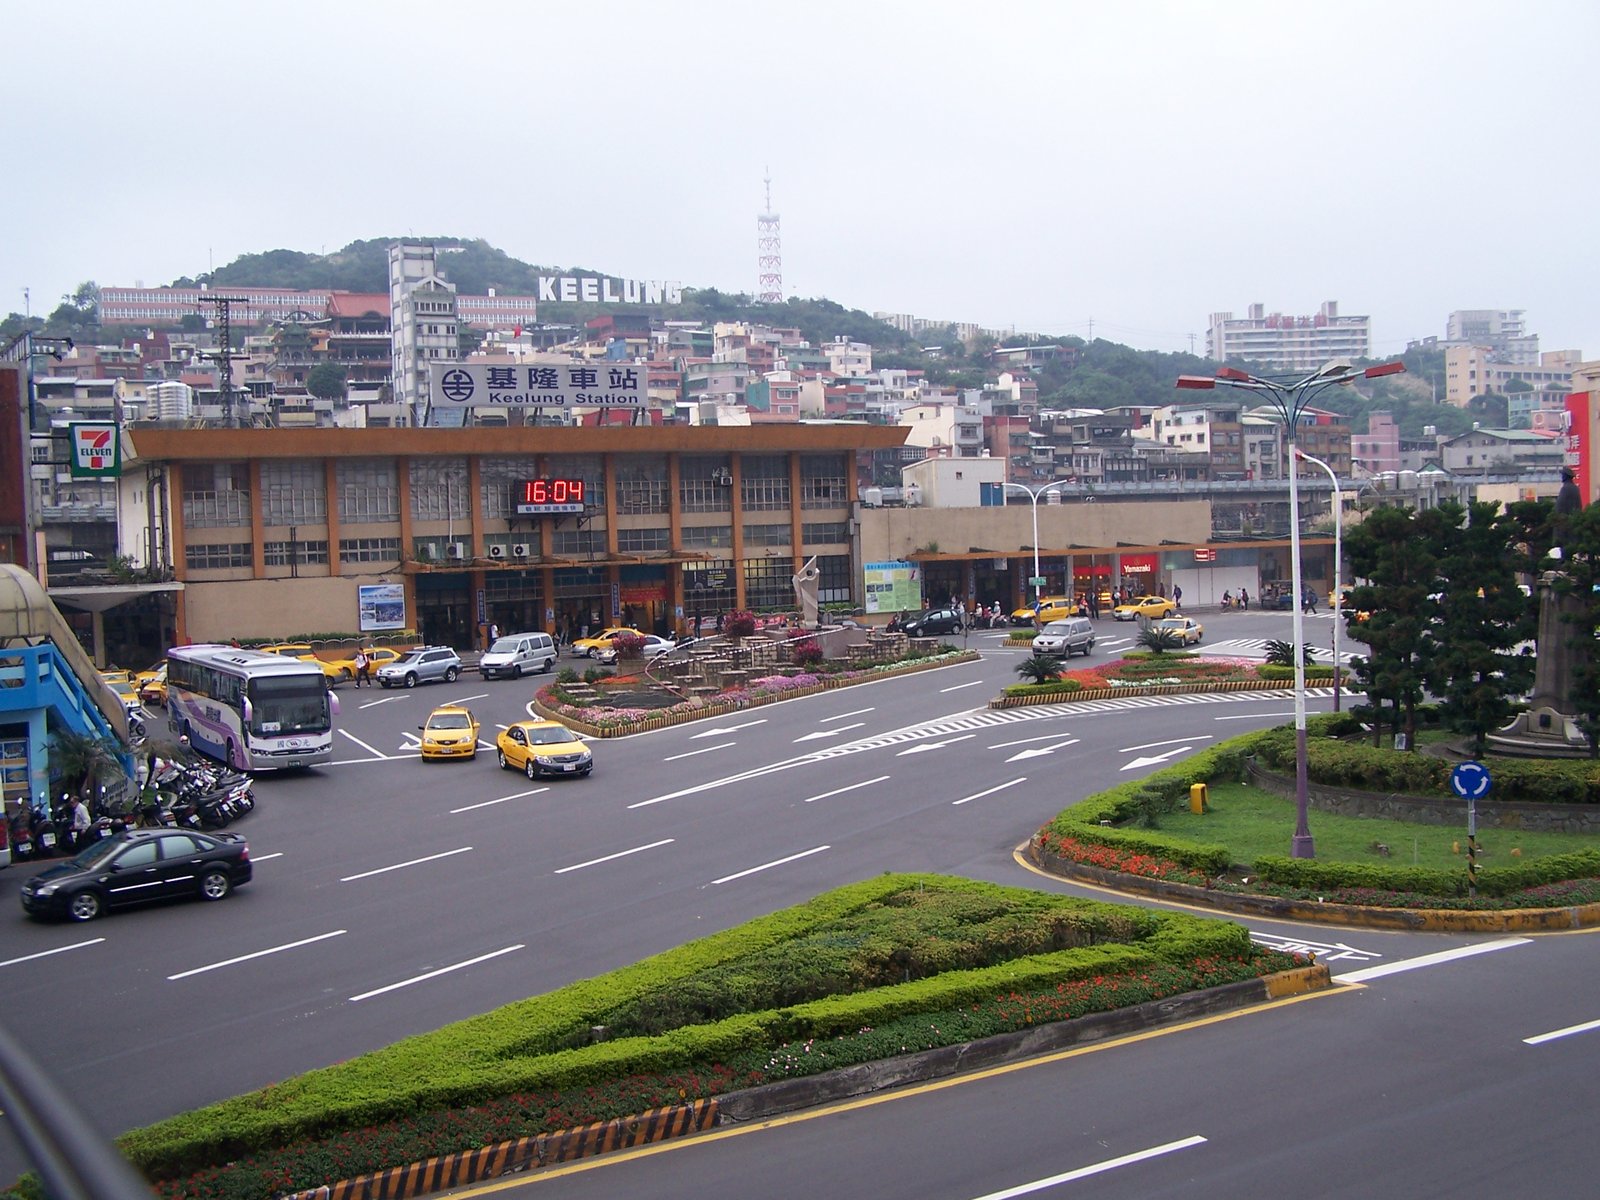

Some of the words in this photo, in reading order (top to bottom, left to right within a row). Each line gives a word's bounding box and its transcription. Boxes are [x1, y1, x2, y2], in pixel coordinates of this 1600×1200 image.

[538, 276, 682, 305] KEELUNG
[486, 367, 638, 390] 基隆車站
[489, 392, 565, 405] Keelung
[575, 393, 639, 404] Station
[81, 430, 110, 468] 7
[526, 481, 582, 502] 16:04
[1123, 564, 1151, 573] Yamazaki
